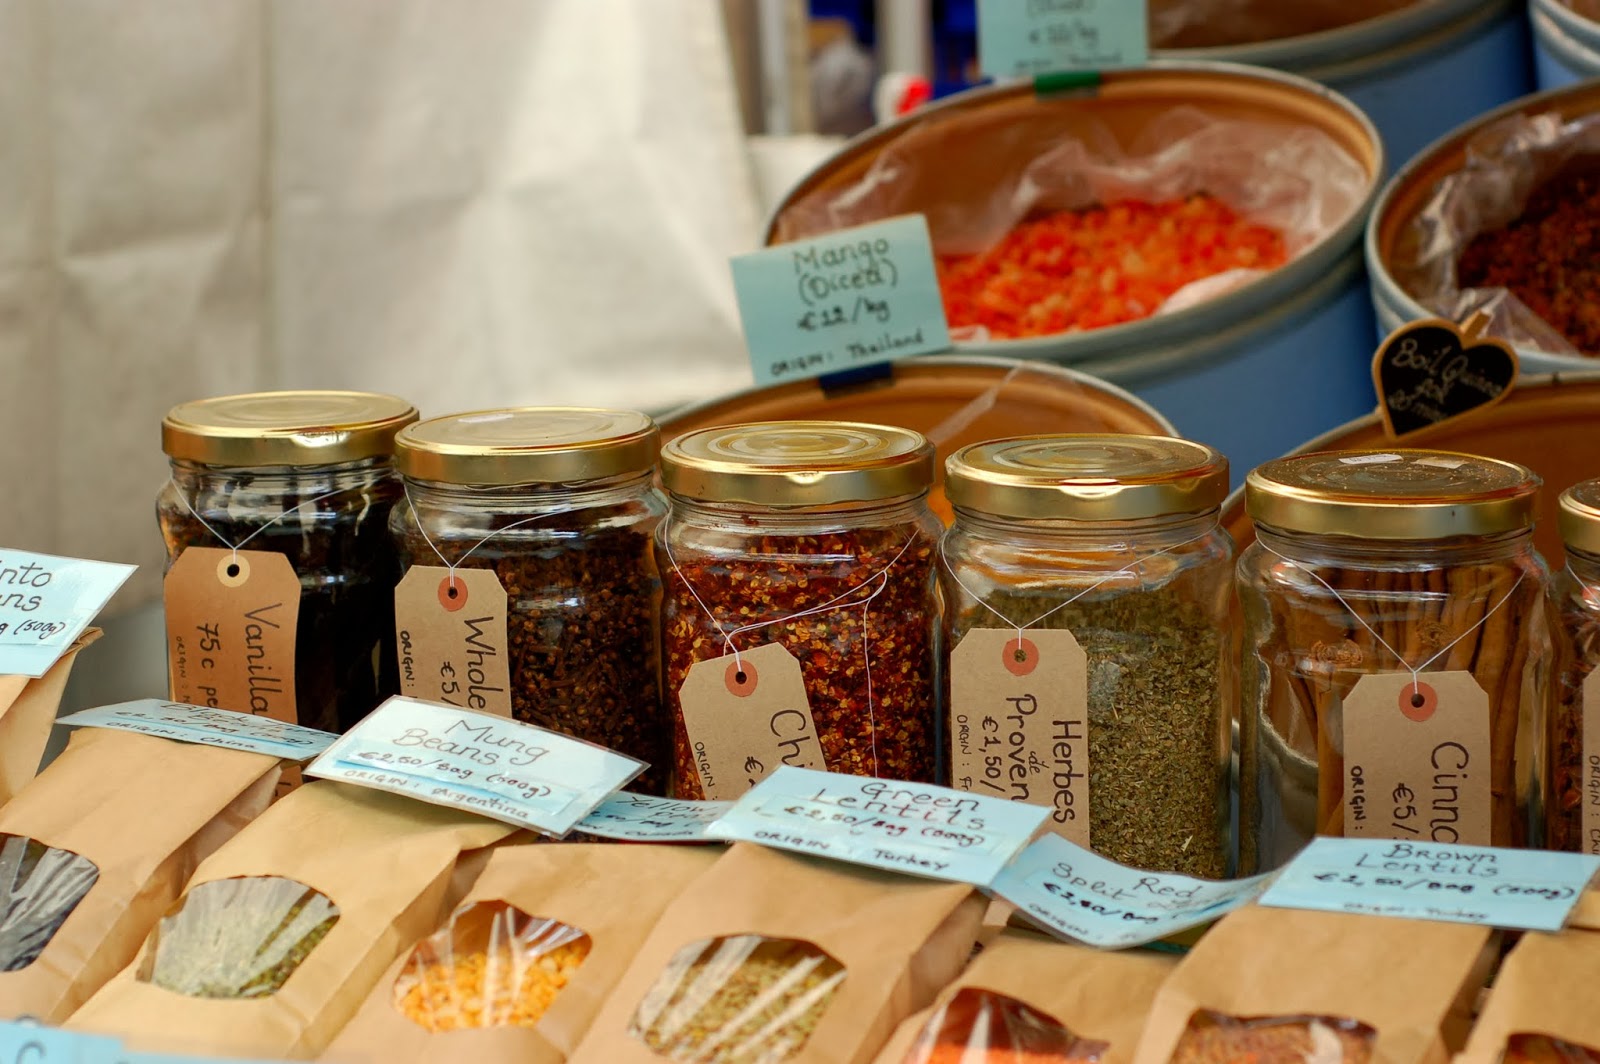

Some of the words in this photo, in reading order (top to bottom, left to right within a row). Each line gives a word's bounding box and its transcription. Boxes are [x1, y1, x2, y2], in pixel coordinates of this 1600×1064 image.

[792, 239, 890, 274] Mango
[799, 258, 898, 306] (Diced)
[846, 328, 924, 358] Thailand
[1392, 338, 1452, 375] Boil
[0, 561, 52, 588] nto
[0, 593, 42, 612] ns
[13, 619, 66, 640] (500g)
[244, 602, 283, 716] Vanilla
[464, 616, 504, 709] Whole
[199, 736, 257, 750] China
[392, 728, 501, 767] Beans
[444, 719, 551, 767] Mung
[1052, 720, 1085, 824] Herbes
[431, 788, 530, 819] Argentina
[616, 796, 718, 813] Yellow
[810, 788, 985, 830] Lentils
[861, 782, 980, 812] Green
[873, 848, 950, 871] Turkey
[1355, 853, 1499, 878] Lentils
[1052, 861, 1137, 899] Split
[1133, 877, 1204, 899] Red
